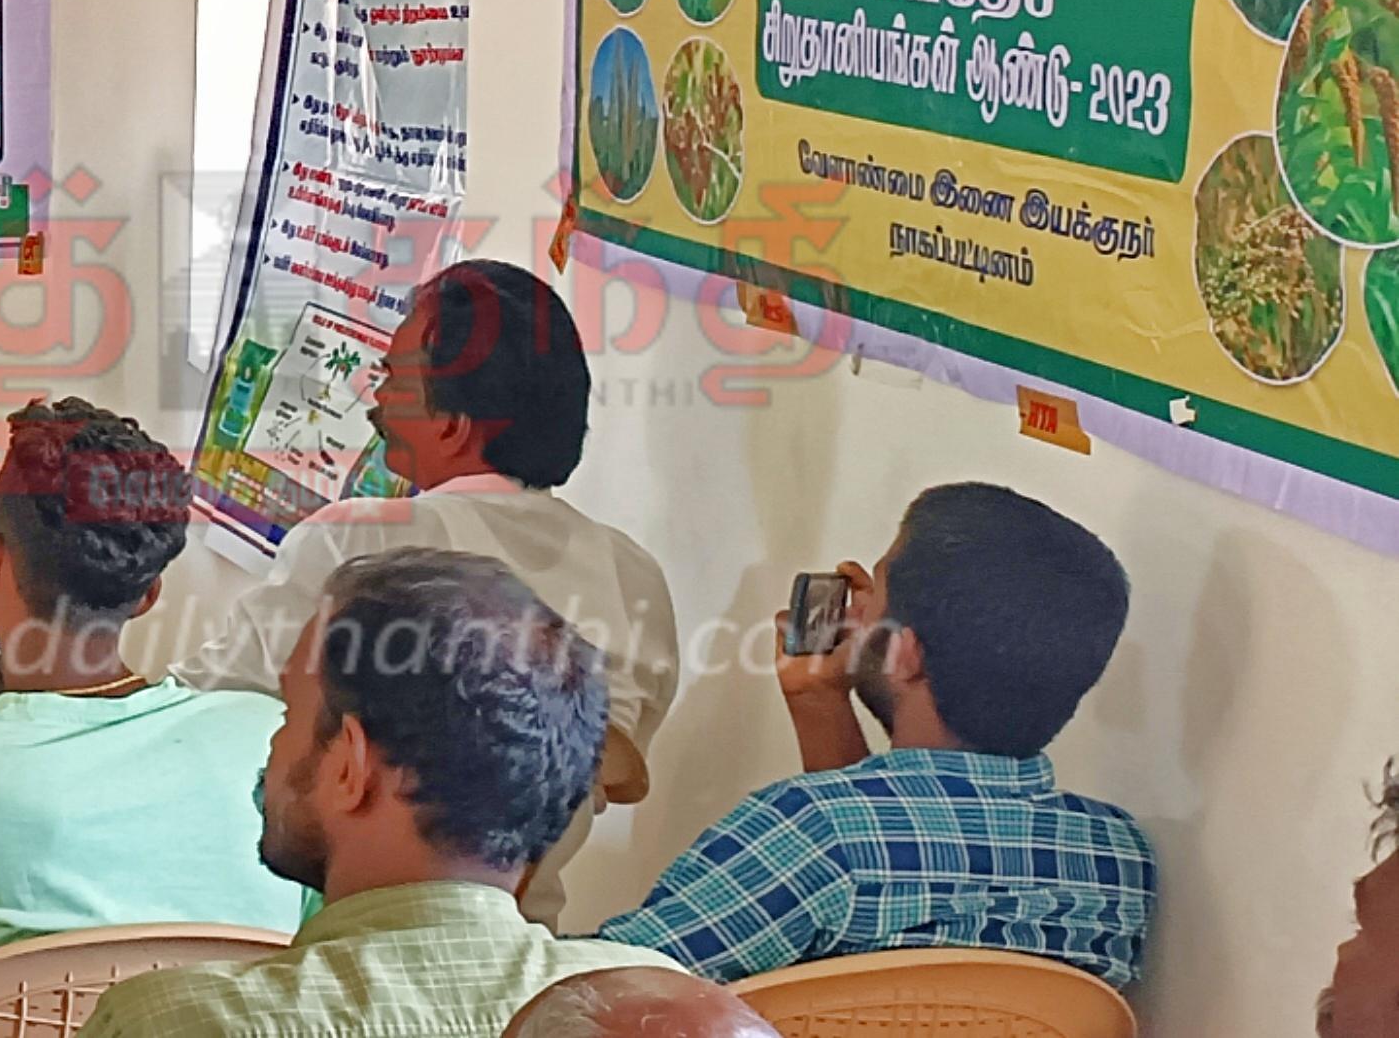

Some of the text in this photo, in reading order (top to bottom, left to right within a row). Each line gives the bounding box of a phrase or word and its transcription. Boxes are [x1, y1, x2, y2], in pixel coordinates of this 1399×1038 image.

[1088, 63, 1172, 136] 2023
[797, 138, 925, 201] வேளாண்மை
[930, 168, 1015, 225] இணை
